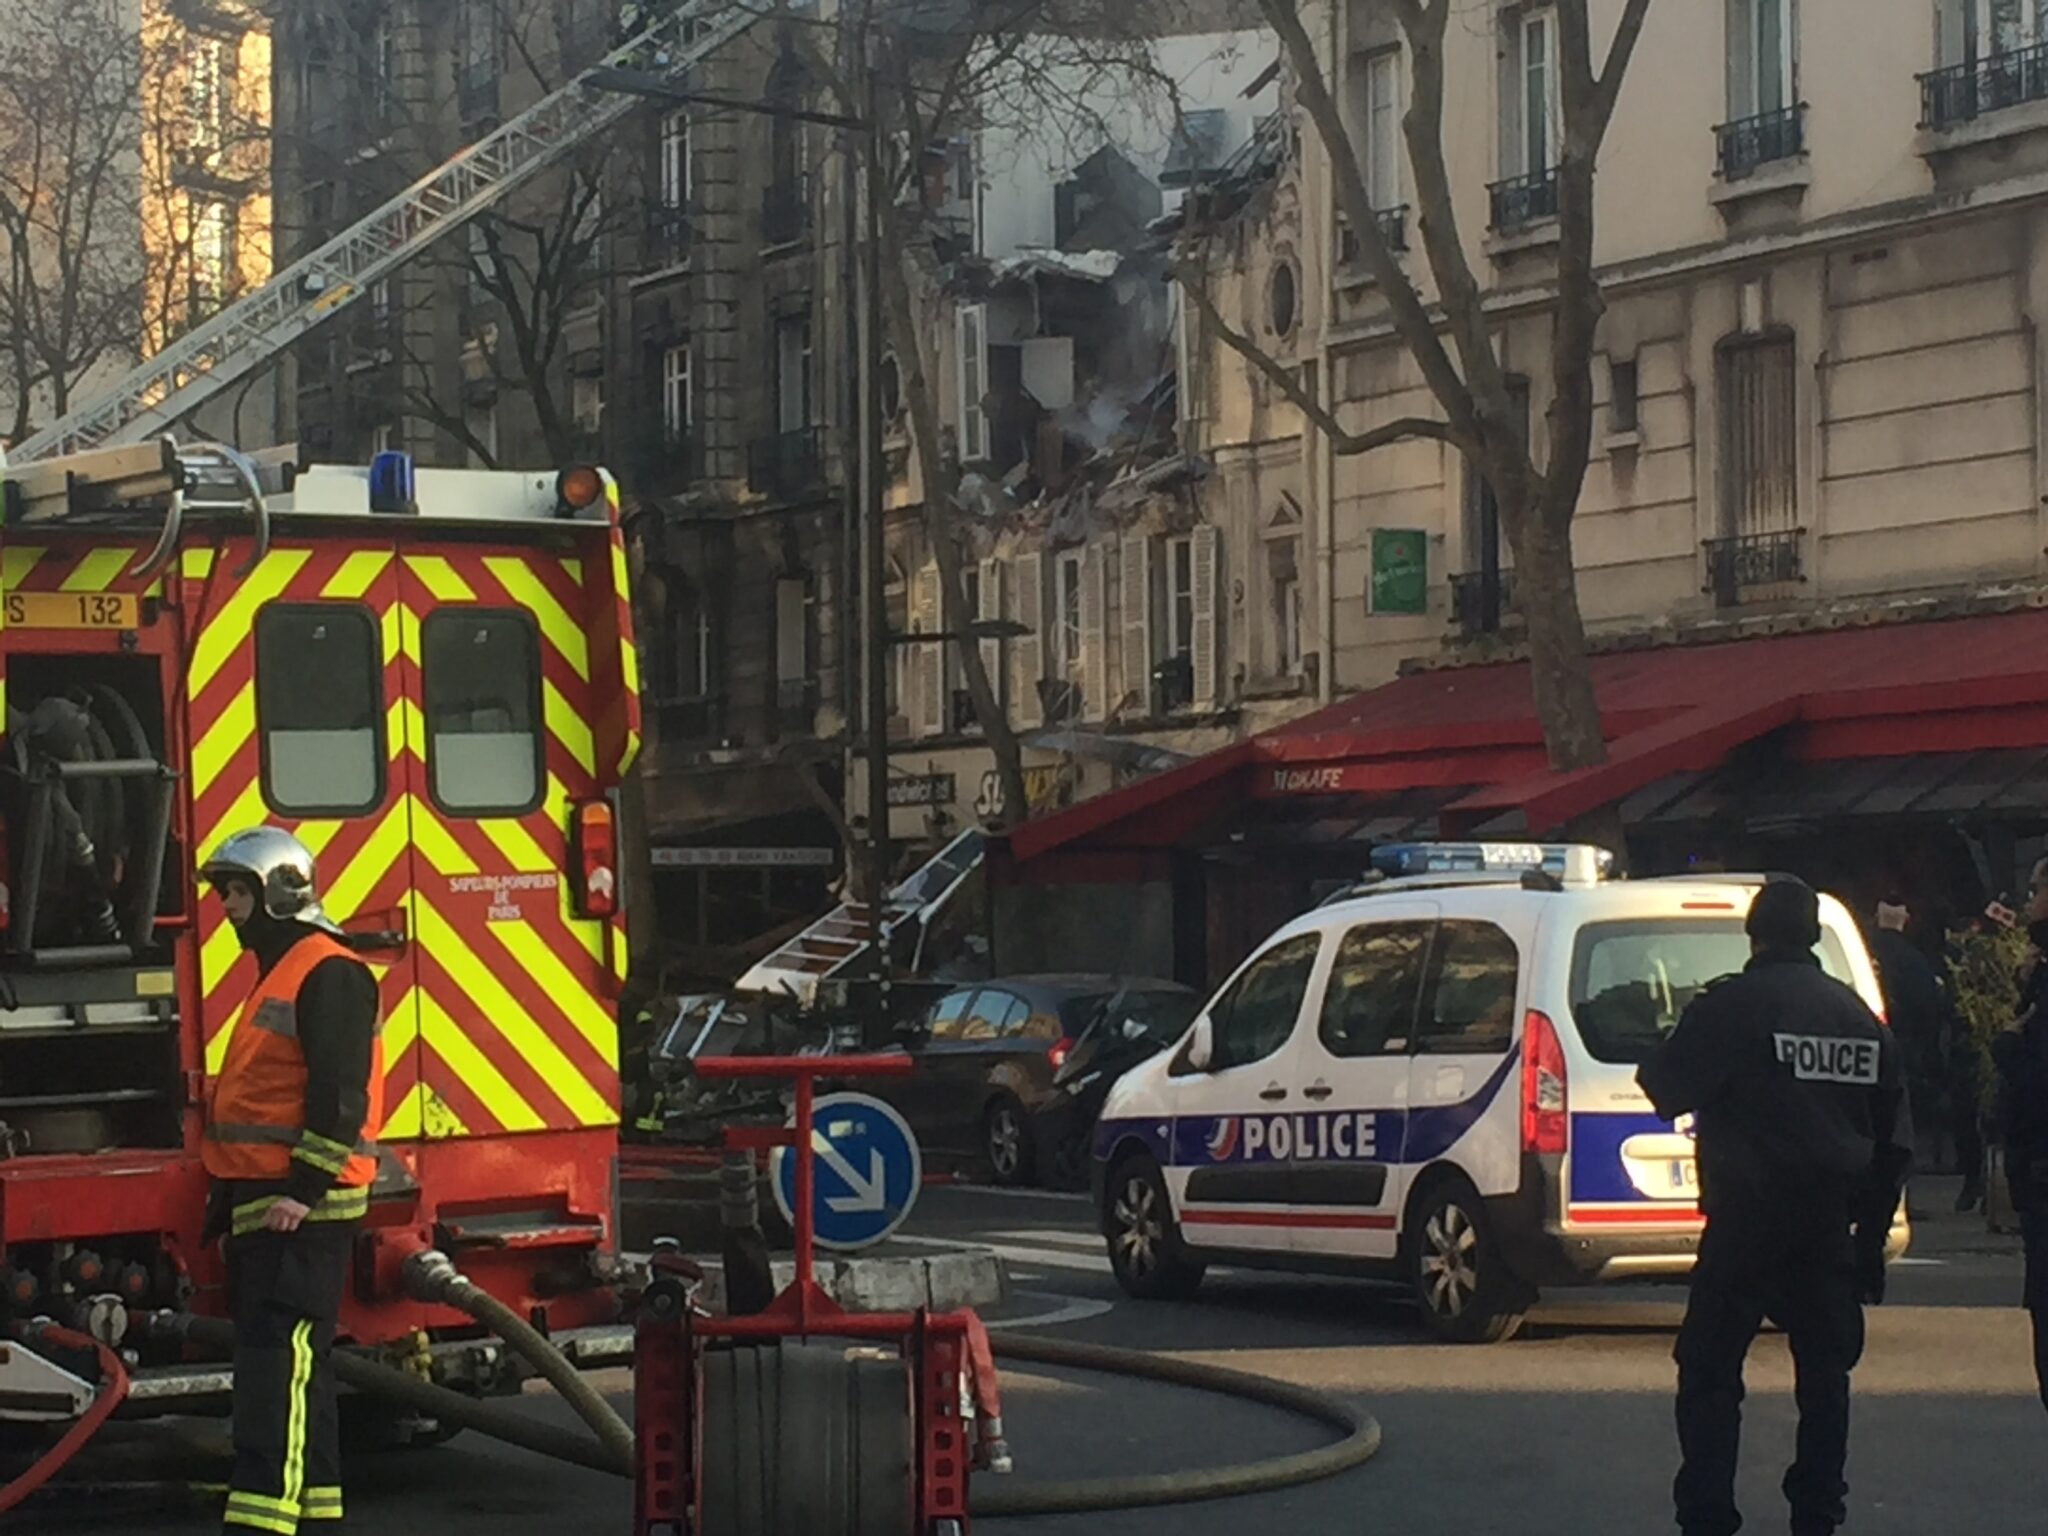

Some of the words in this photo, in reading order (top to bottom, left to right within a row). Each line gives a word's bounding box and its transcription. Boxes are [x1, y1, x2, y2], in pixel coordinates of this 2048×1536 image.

[78, 596, 122, 624] 132
[1781, 1039, 1873, 1078] POLICE
[1243, 1113, 1376, 1159] POLICE
